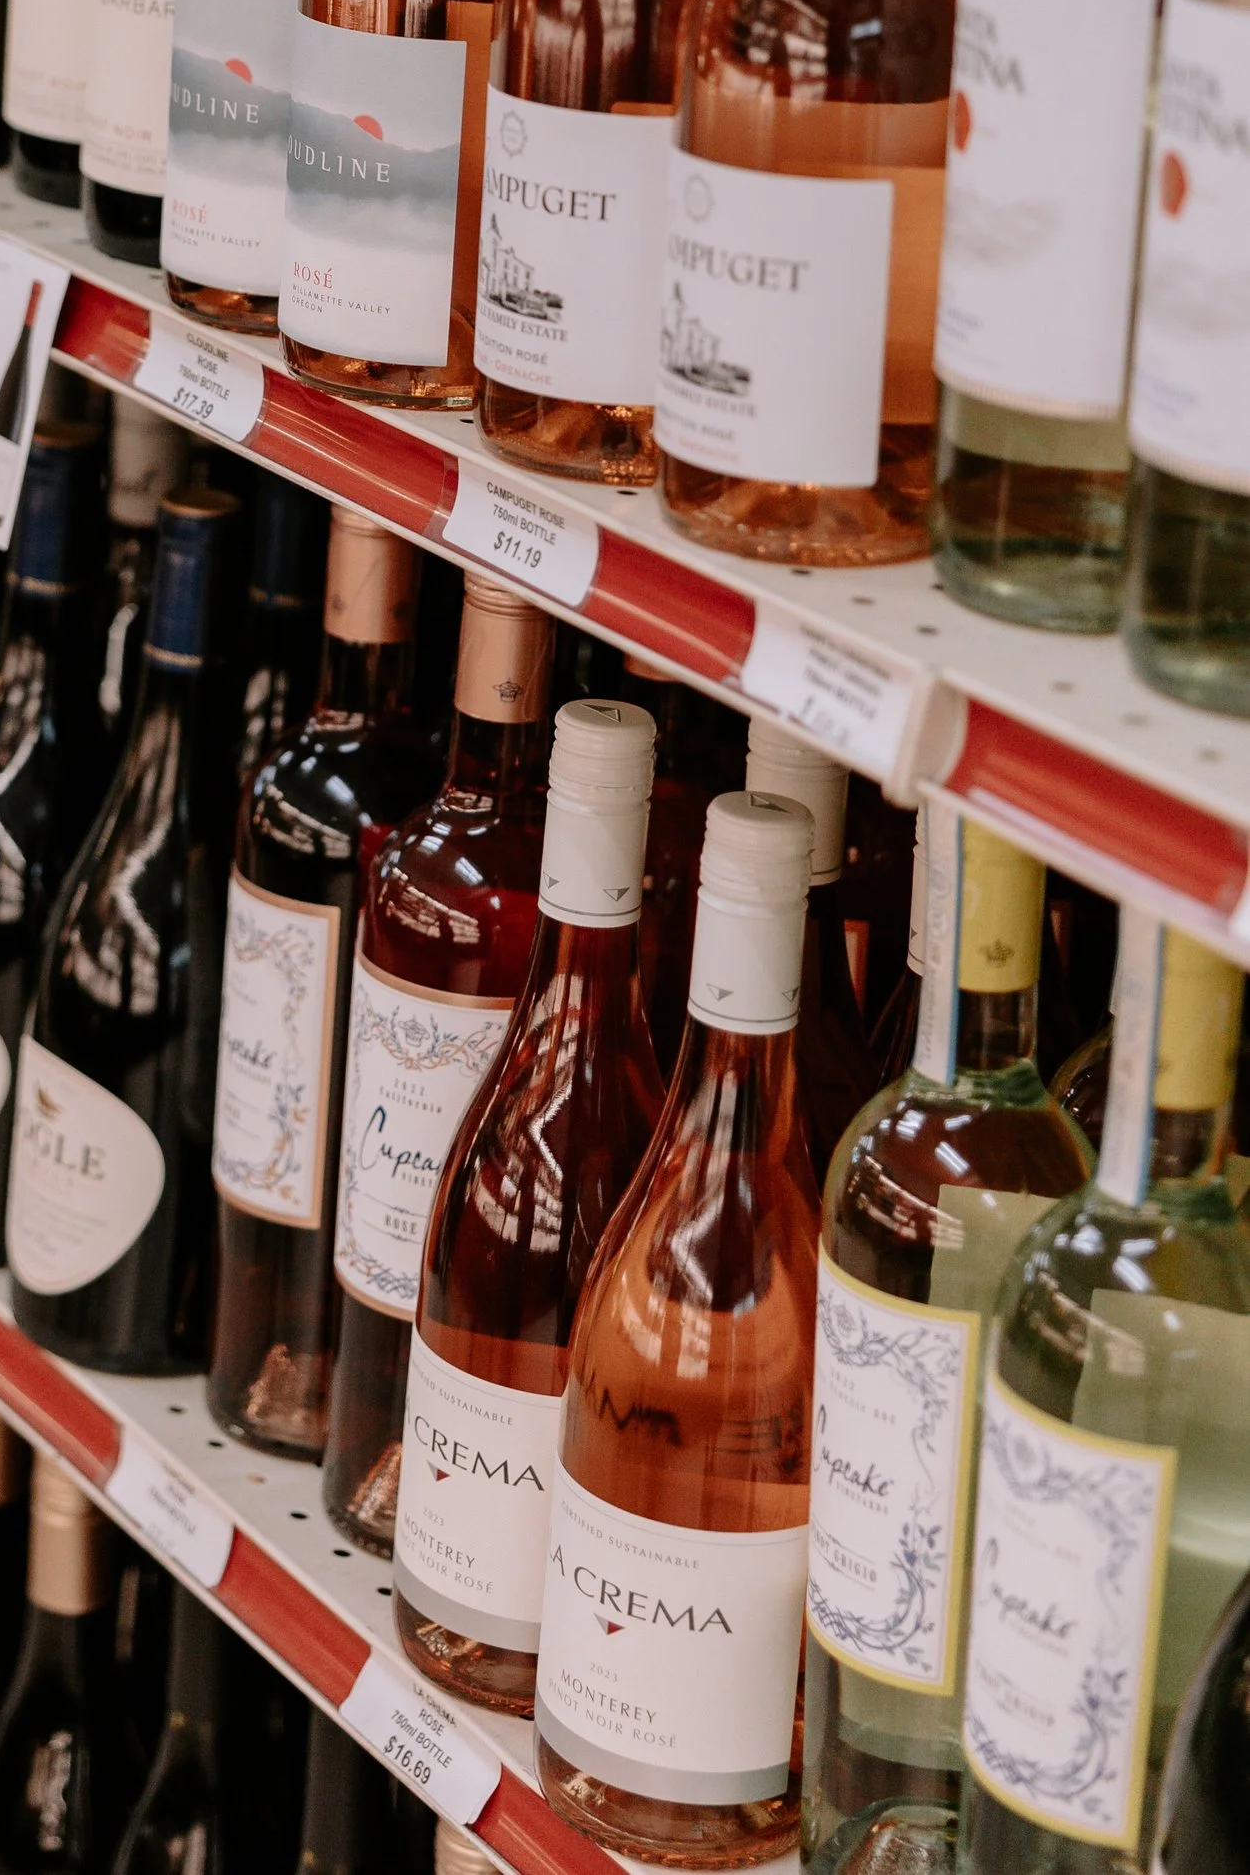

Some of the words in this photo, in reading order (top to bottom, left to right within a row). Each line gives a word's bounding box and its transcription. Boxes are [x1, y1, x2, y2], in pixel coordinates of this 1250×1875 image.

[171, 198, 209, 225] ROSÉ
[221, 235, 262, 249] VALLEY
[293, 261, 334, 289] ROSÉ
[291, 283, 344, 308] WILLAMETTE
[347, 300, 392, 315] VALLEY
[291, 296, 324, 314] OREGON
[186, 331, 230, 364] CLOUDLINE
[520, 322, 569, 343] ESTATE
[196, 354, 220, 375] ROSE
[515, 347, 549, 366] ROSÉ
[172, 386, 215, 420] $17.39
[199, 375, 231, 402] BOTTLE
[486, 480, 539, 516] CAMPUGET
[538, 506, 566, 531] ROSE
[492, 503, 519, 527] 750ml
[519, 517, 558, 547] BOTTLE
[493, 530, 543, 569] $11.19
[438, 1387, 515, 1427] SUSTAINABLE
[414, 1414, 546, 1492] CREMA
[813, 1402, 896, 1498] Cupcake
[403, 1511, 476, 1569] MONTEREY
[560, 1500, 604, 1540] CERTIFIED
[607, 1535, 701, 1571] SUSTAINABLE
[419, 1550, 448, 1578] NOIR
[453, 1571, 494, 1594] ROSÉ
[573, 1565, 735, 1635] CREMA
[590, 1661, 619, 1683] 2023
[548, 1677, 580, 1713] PINOT
[585, 1708, 624, 1736] NOIR
[632, 1727, 679, 1750] ROSÉ
[560, 1668, 658, 1725] MONTEREY
[417, 1707, 446, 1738] ROSE
[383, 1734, 432, 1786] $16.69
[415, 1731, 454, 1770] BOTTLE
